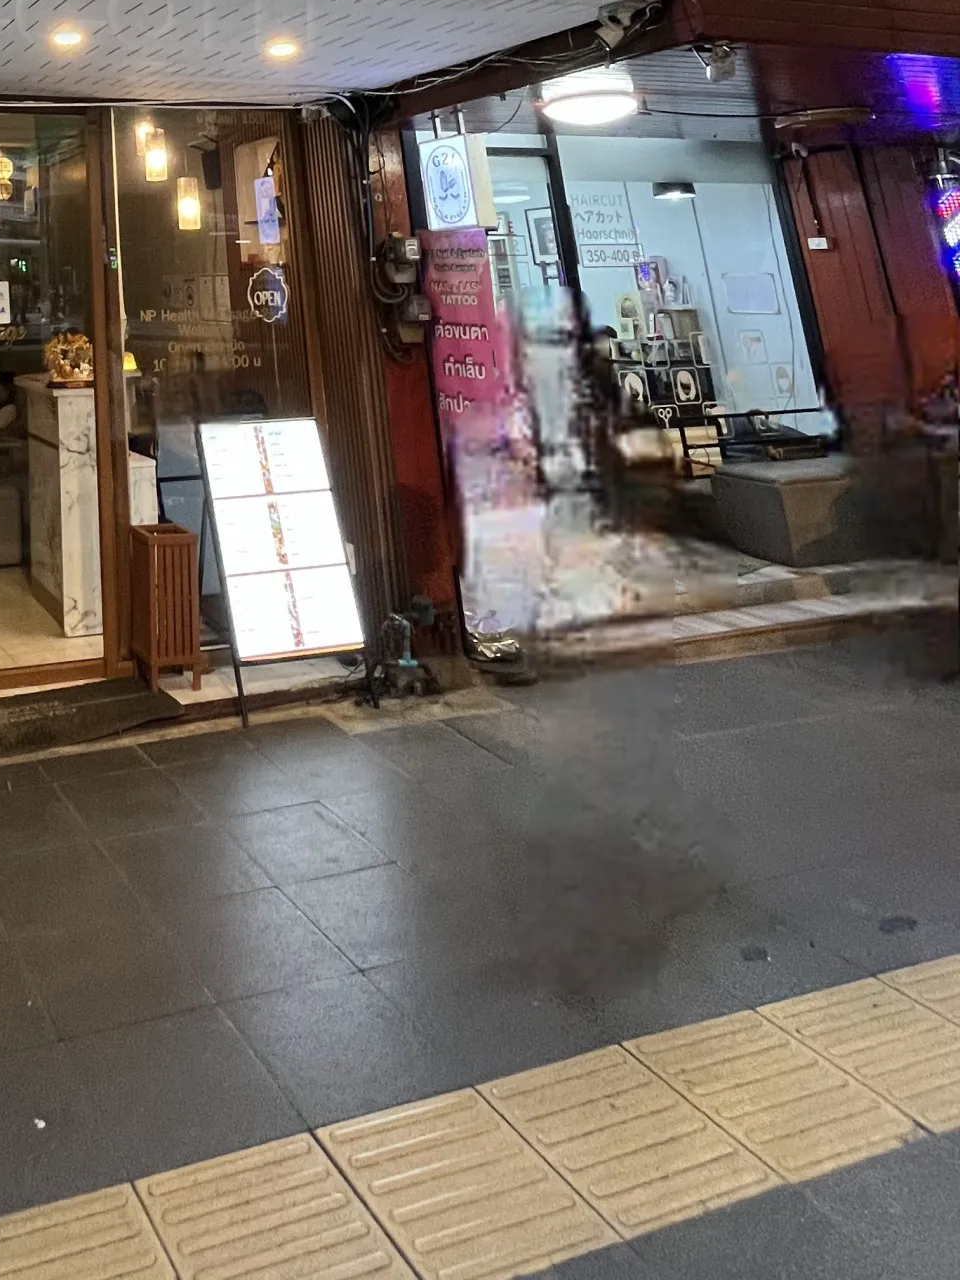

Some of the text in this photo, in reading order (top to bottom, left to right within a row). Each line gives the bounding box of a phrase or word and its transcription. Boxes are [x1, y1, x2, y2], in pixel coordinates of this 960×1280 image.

[574, 210, 623, 224] ヘアカット
[586, 250, 630, 263] 350-400
[253, 291, 282, 307] OPEN
[441, 294, 478, 306] TATTOO
[140, 309, 157, 323] NP
[444, 355, 487, 380] ทำเล็บ
